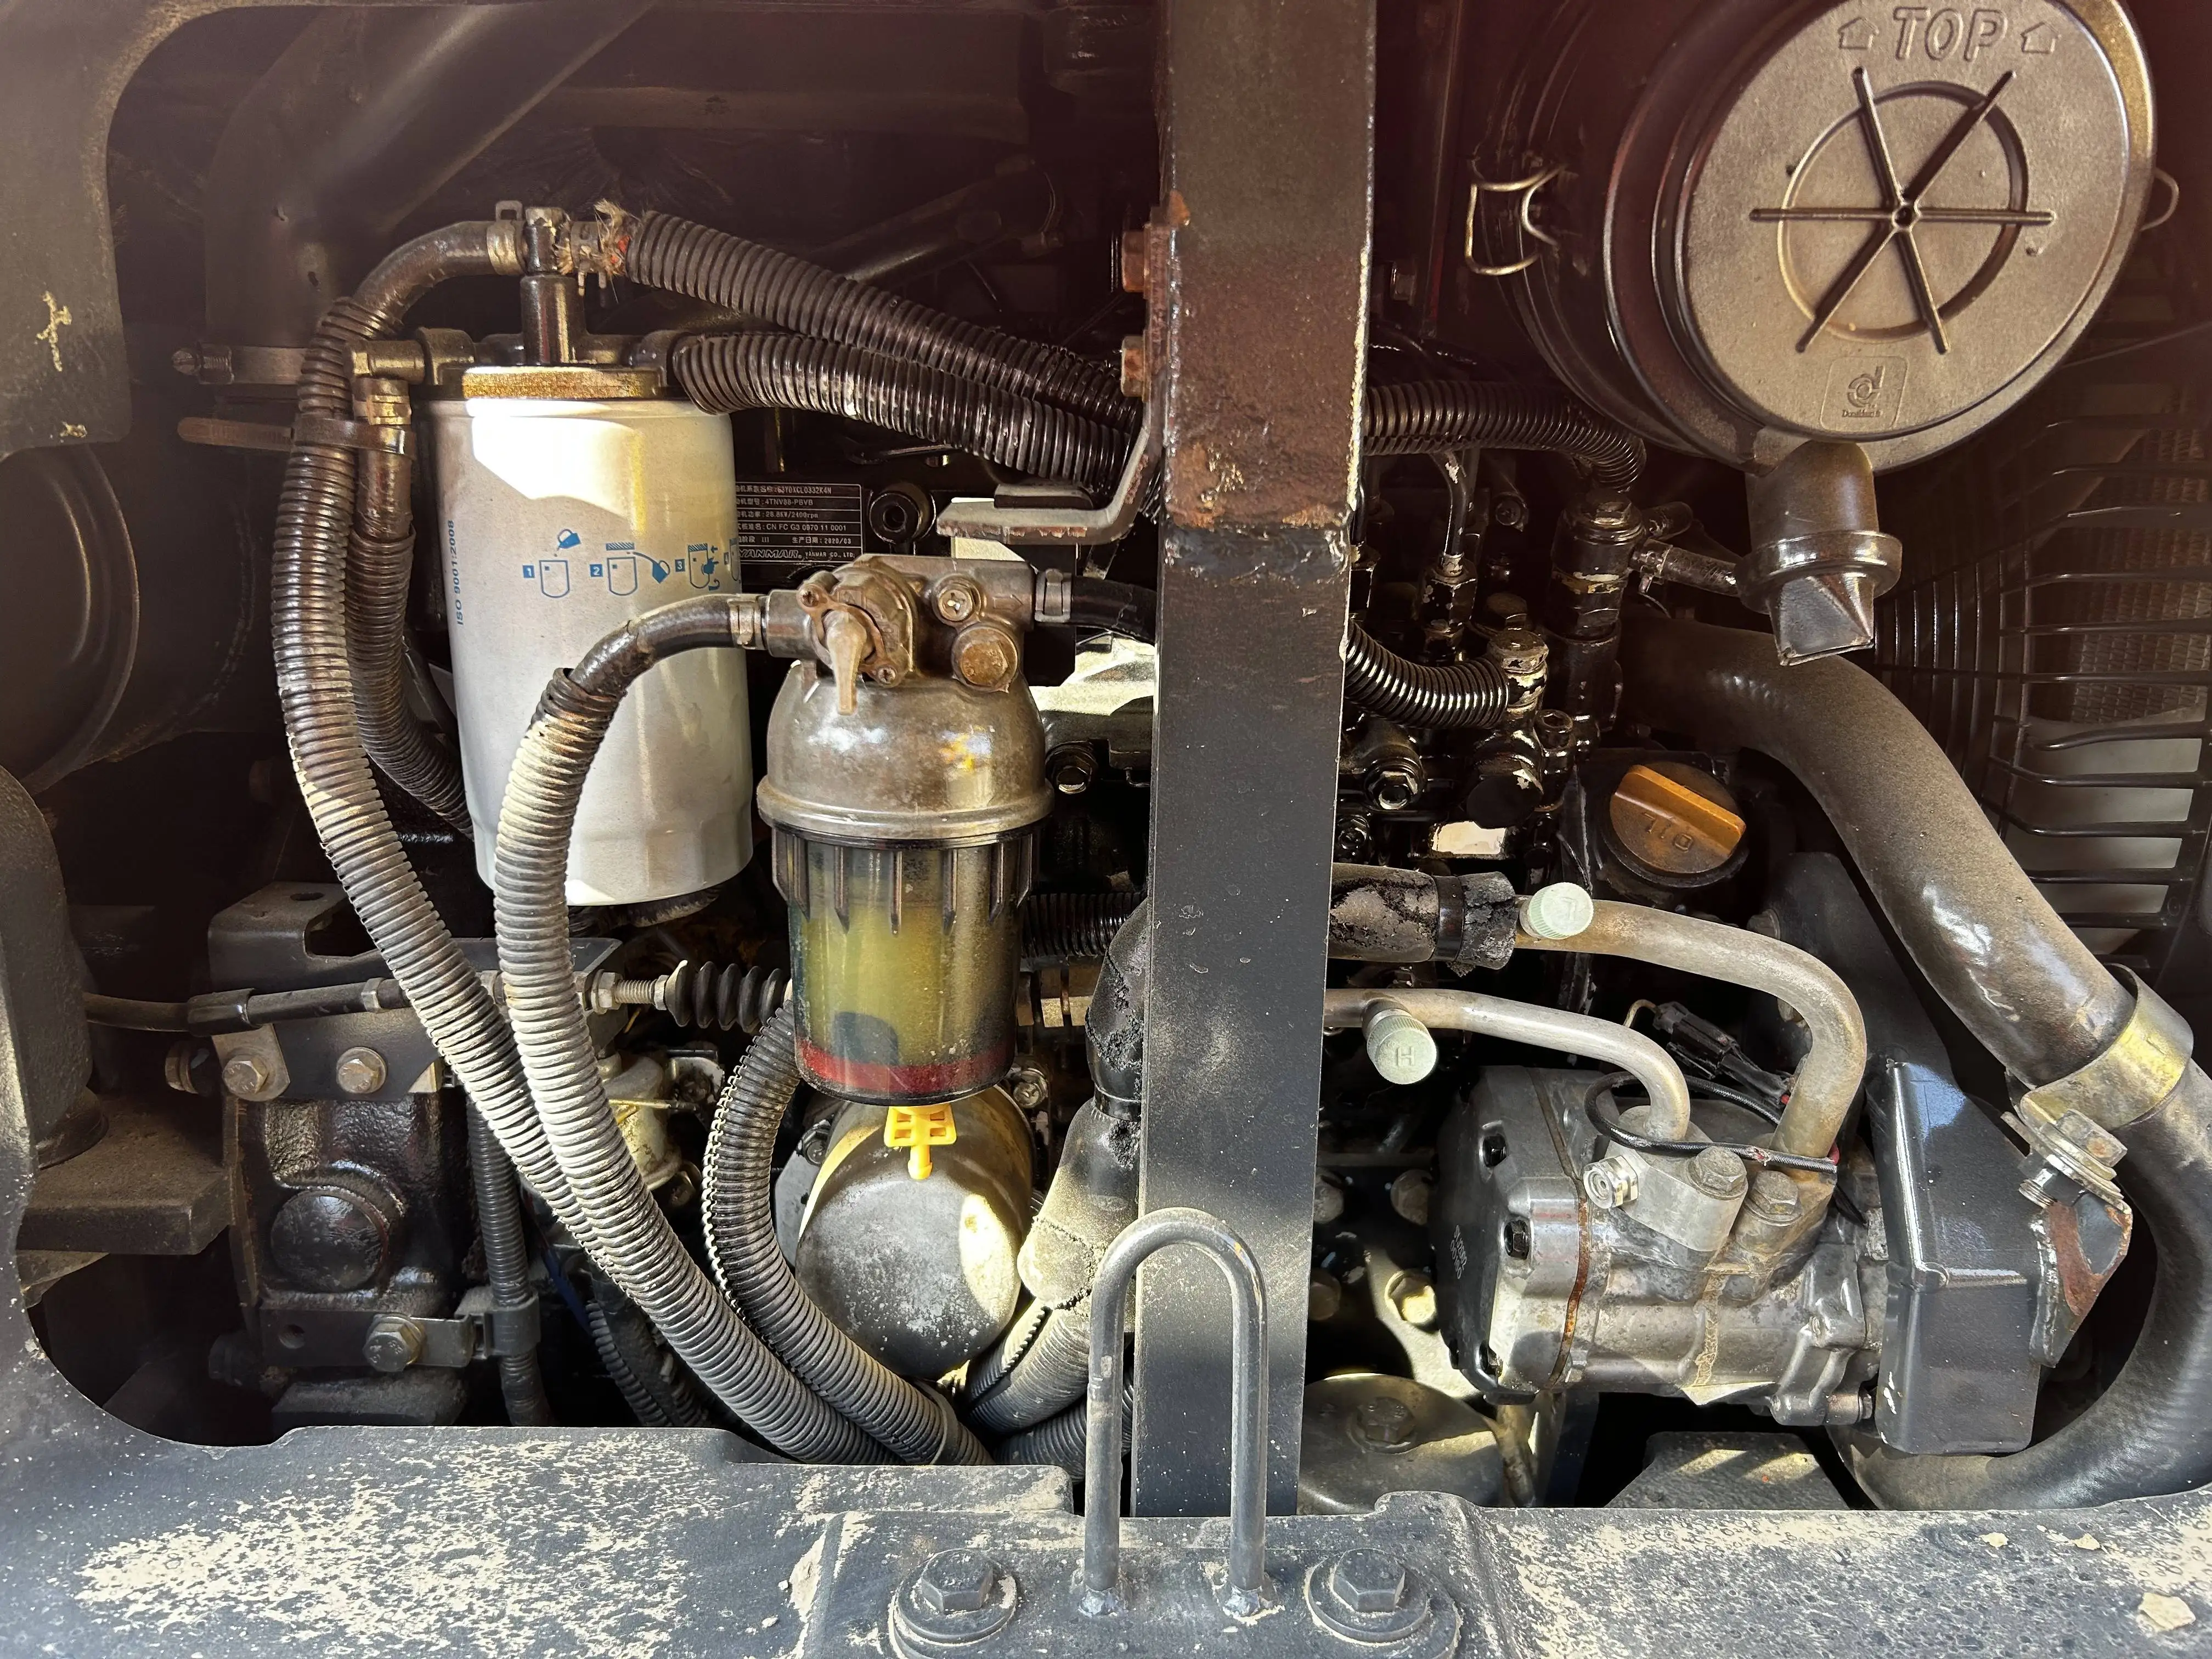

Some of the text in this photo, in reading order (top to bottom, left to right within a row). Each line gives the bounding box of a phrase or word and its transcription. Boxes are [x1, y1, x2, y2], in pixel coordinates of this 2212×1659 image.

[1894, 7, 2007, 61] TOP
[448, 520, 464, 626] ISO 9001:2008
[1642, 812, 1694, 853] OIL
[1396, 1046, 1415, 1067] H
